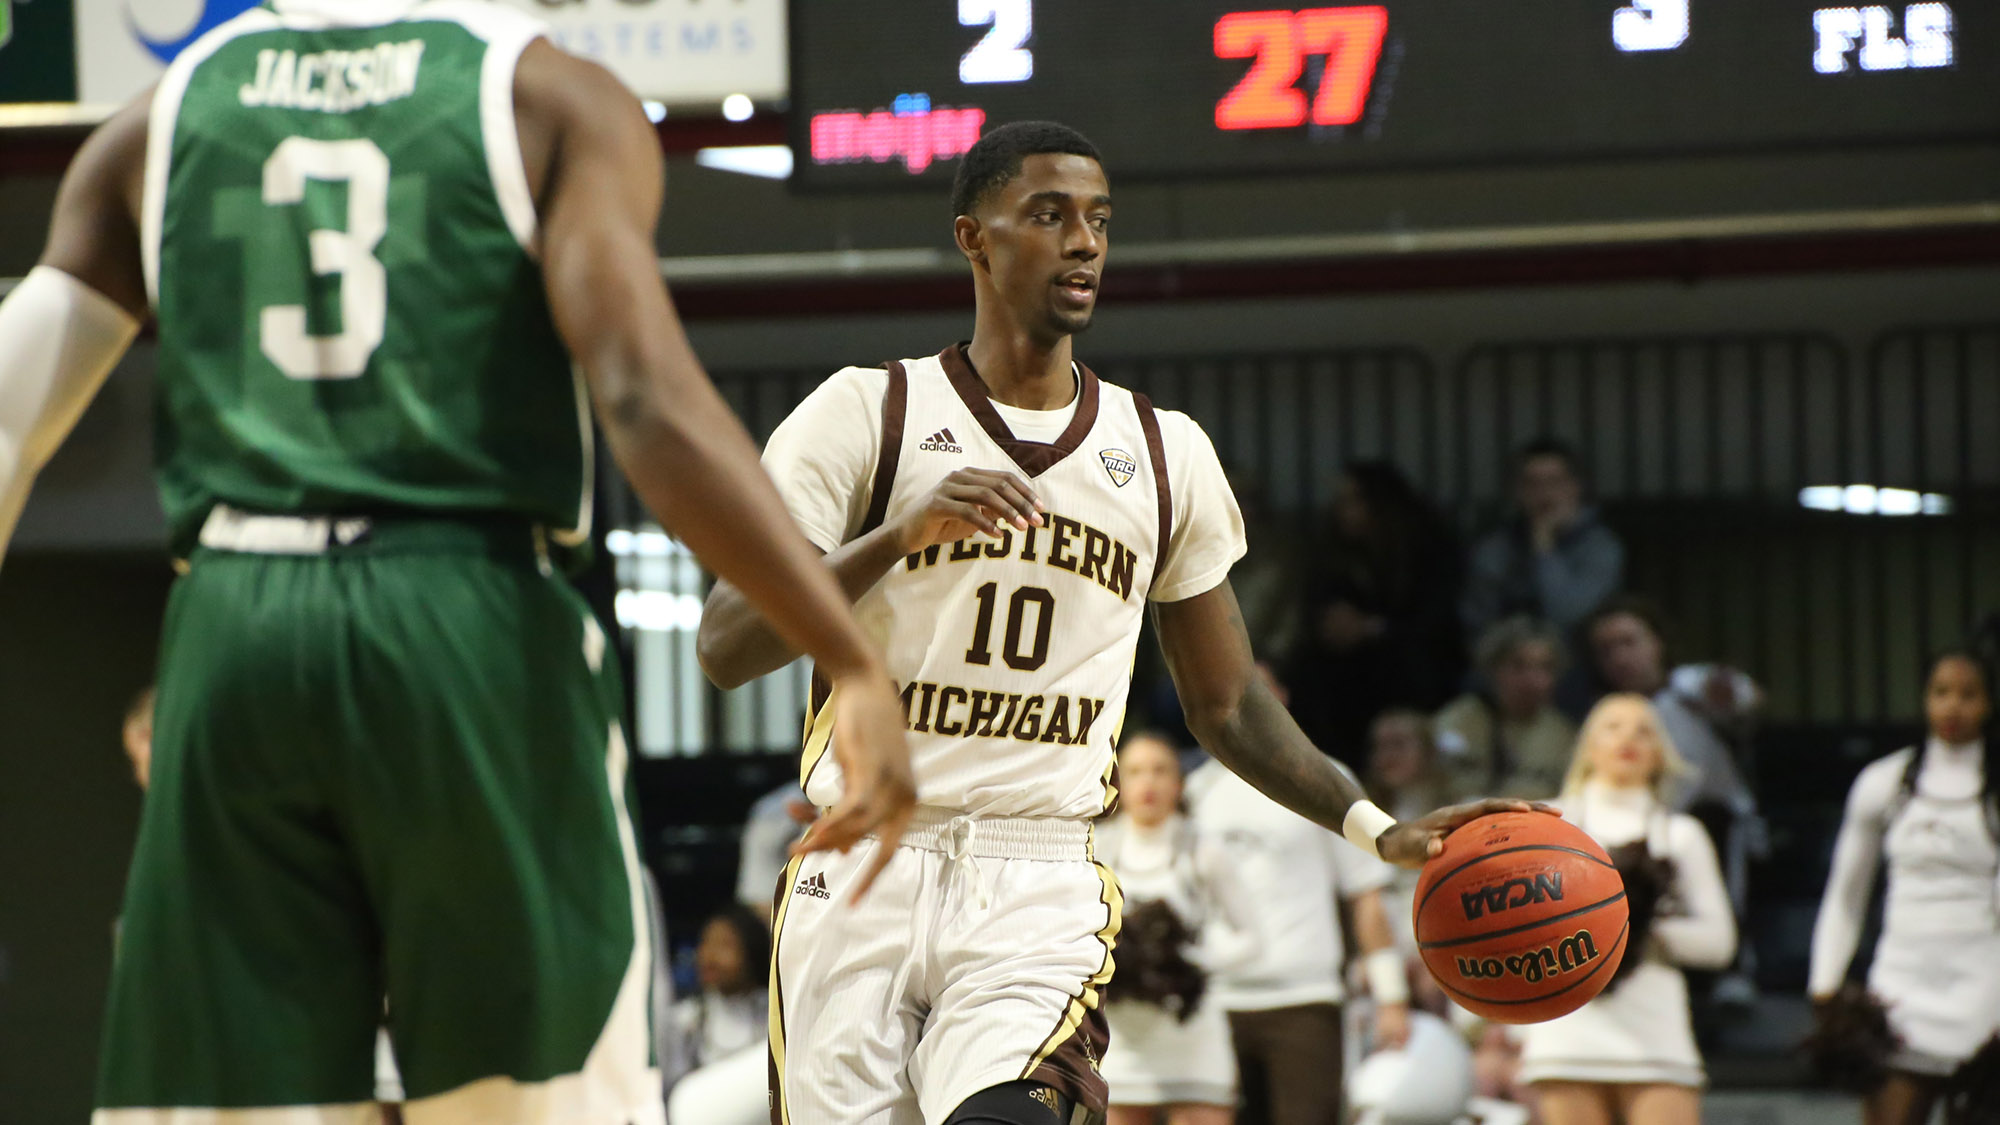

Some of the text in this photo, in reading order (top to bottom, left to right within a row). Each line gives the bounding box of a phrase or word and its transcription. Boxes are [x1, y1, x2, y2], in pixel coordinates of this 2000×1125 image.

[958, 0, 1034, 83] 2
[1213, 5, 1389, 130] 27
[1813, 2, 1954, 73] FLS
[238, 38, 425, 113] JACKSON
[259, 134, 391, 381] 3
[919, 441, 963, 454] adidas
[964, 580, 1056, 672] 10
[795, 885, 831, 900] addas
[1460, 871, 1564, 921] NCAA
[1456, 929, 1600, 984] Wilson
